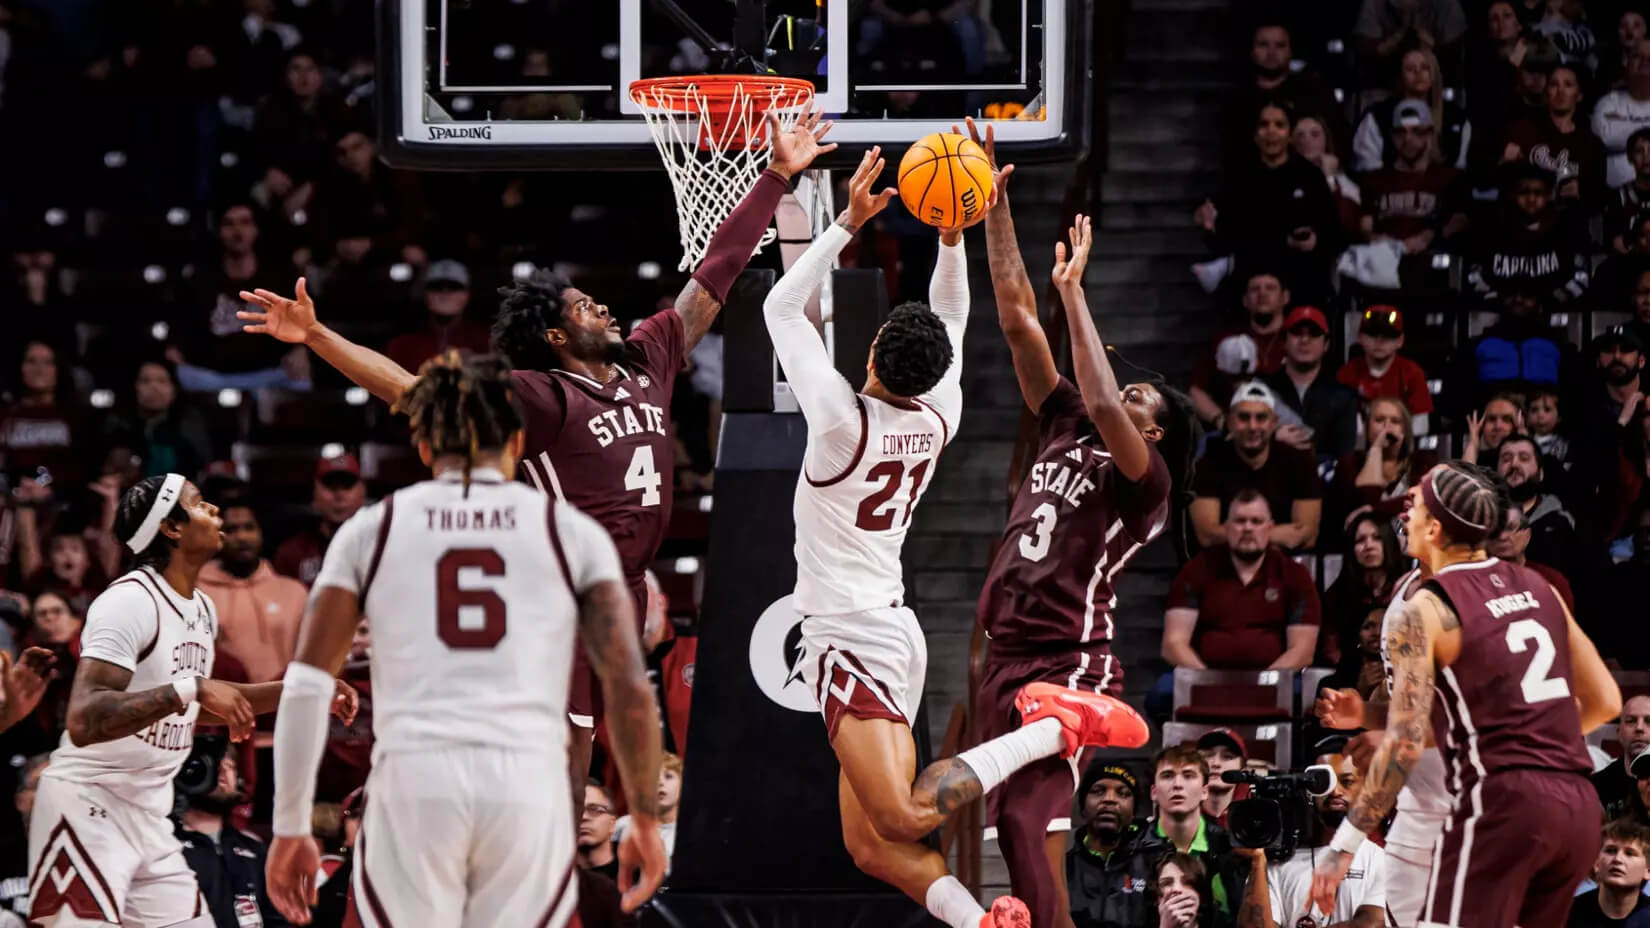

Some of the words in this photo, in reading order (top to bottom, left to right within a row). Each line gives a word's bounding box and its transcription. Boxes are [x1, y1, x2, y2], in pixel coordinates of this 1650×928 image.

[428, 126, 491, 140] SPALDING
[587, 402, 666, 448] STATE
[882, 433, 934, 455] CONYERS
[624, 445, 662, 506] 4
[855, 458, 931, 531] 21
[1031, 462, 1096, 508] STATE
[424, 507, 517, 531] THOMAS
[1018, 502, 1057, 562] 3
[436, 547, 507, 650] 6
[171, 641, 207, 676] SOUTH
[1505, 619, 1571, 704] 2
